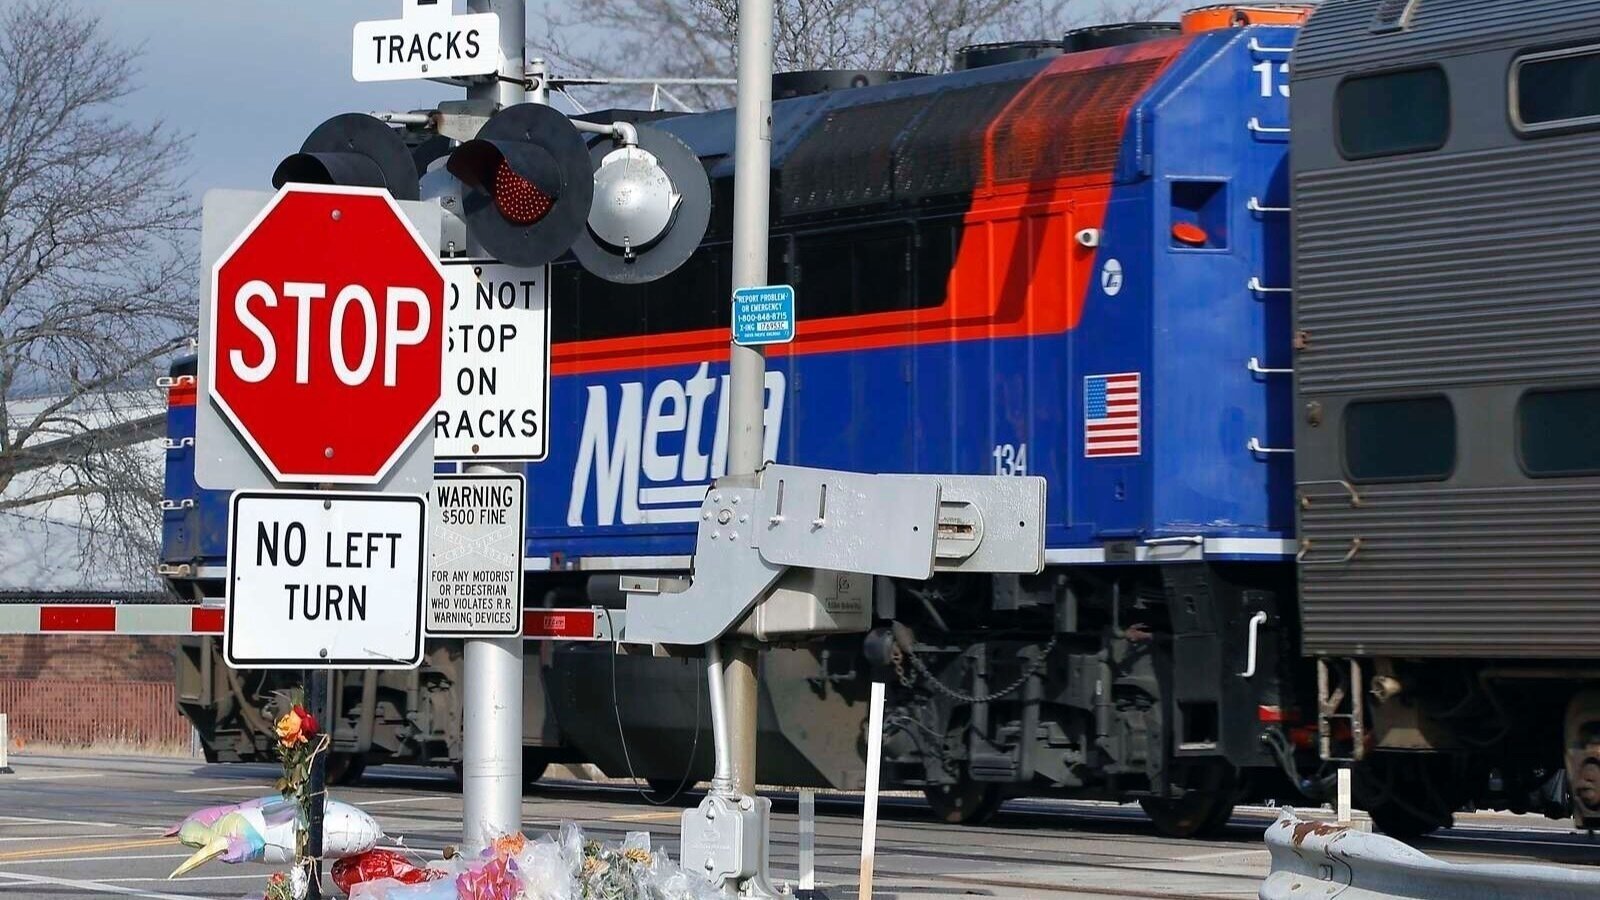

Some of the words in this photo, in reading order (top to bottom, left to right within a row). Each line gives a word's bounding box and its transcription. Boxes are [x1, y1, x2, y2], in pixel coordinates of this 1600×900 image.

[373, 29, 480, 64] TRACKS
[476, 281, 536, 310] NOT
[738, 295, 758, 303] REPORT
[760, 293, 785, 301] PROBLEM
[738, 312, 787, 322] 1-800-848-8715
[750, 304, 782, 312] EMERGENCY
[229, 279, 431, 387] STOP
[457, 367, 496, 395] ON
[434, 409, 538, 438] RACKS
[992, 443, 1027, 478] 134
[437, 486, 513, 507] WARNING
[442, 509, 474, 525] $500
[480, 509, 506, 524] FINE
[256, 521, 306, 567] NO
[326, 531, 402, 568] LEFT
[432, 571, 448, 582] FOR
[452, 571, 469, 582] ANY
[473, 571, 514, 582] MOTORIST
[439, 584, 451, 596] OR
[454, 584, 507, 596] PEDESTRIAN
[284, 584, 367, 620] TURN
[431, 598, 449, 609] WHO
[453, 598, 493, 609] VIOLATES
[497, 598, 513, 609] R.R.
[434, 611, 472, 623] WARNING
[475, 611, 511, 623] DEVICES
